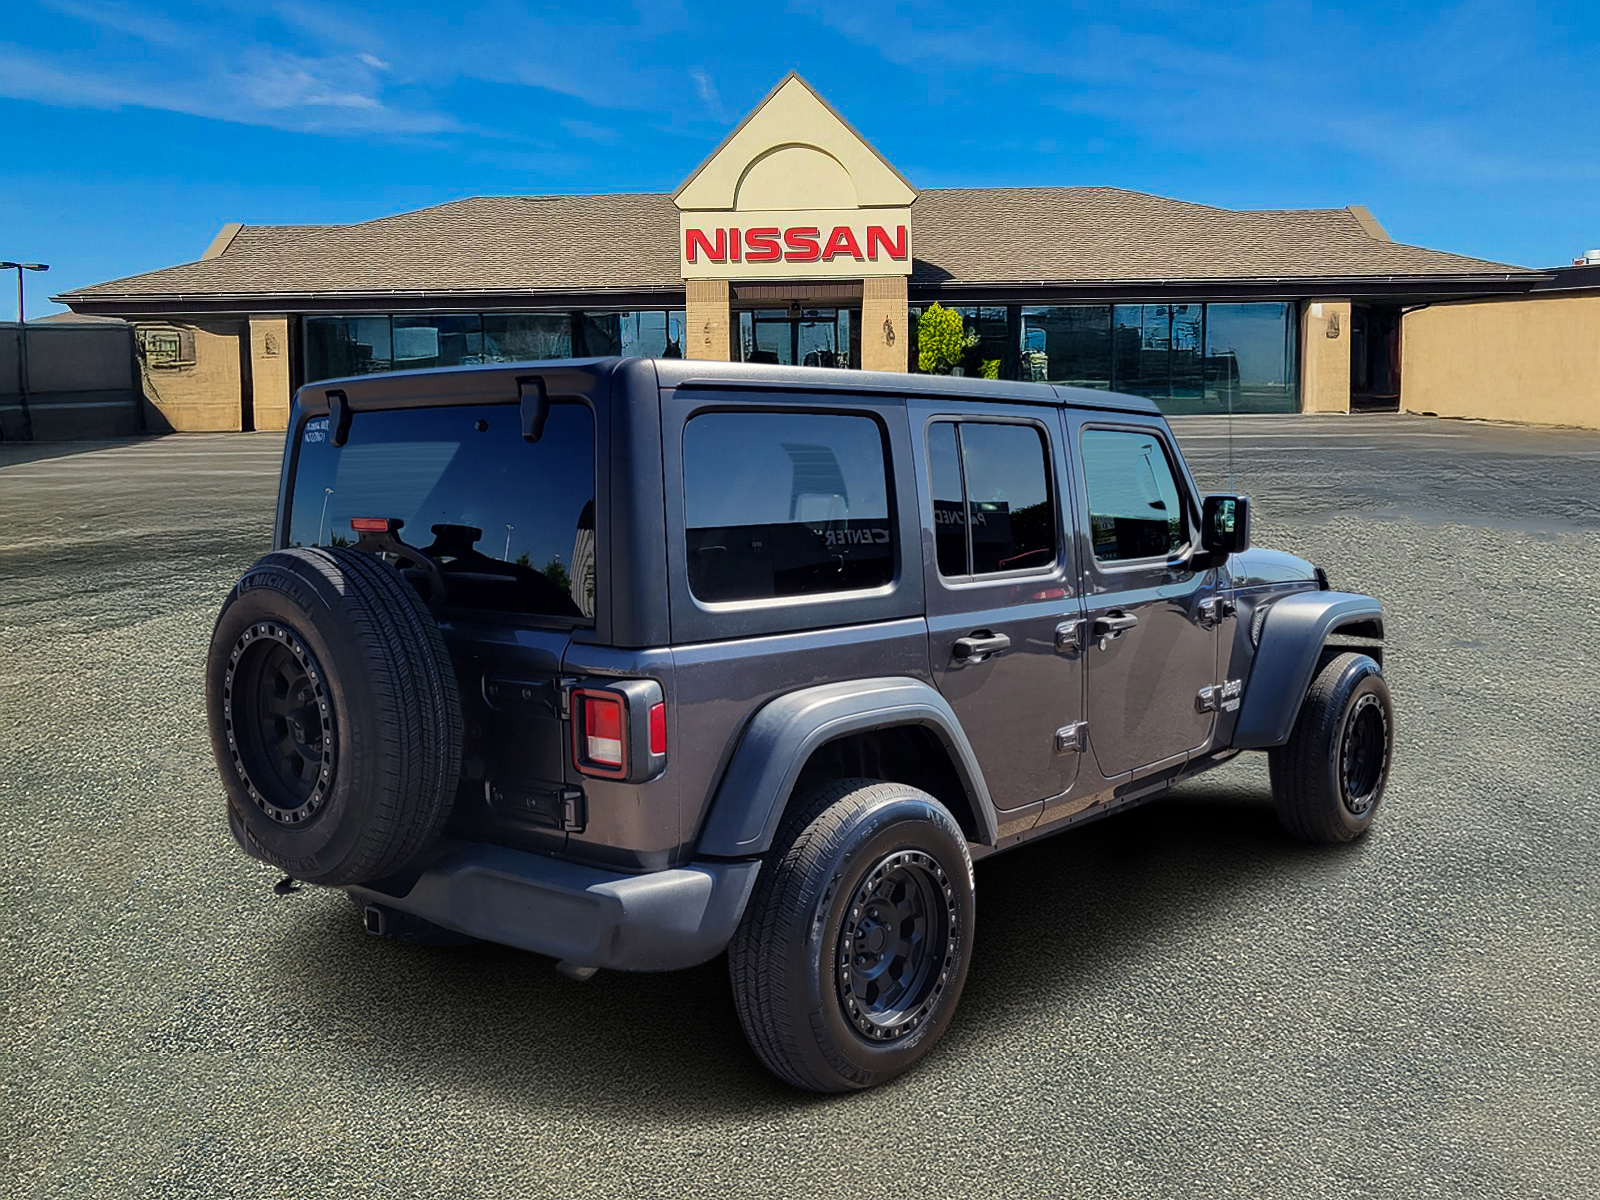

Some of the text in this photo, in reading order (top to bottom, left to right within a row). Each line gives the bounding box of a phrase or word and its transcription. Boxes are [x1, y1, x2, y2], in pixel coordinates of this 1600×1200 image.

[685, 225, 908, 264] NISSAN
[252, 573, 312, 609] MICHELIN
[1221, 678, 1242, 698] Jeep
[817, 873, 842, 922] LTX
